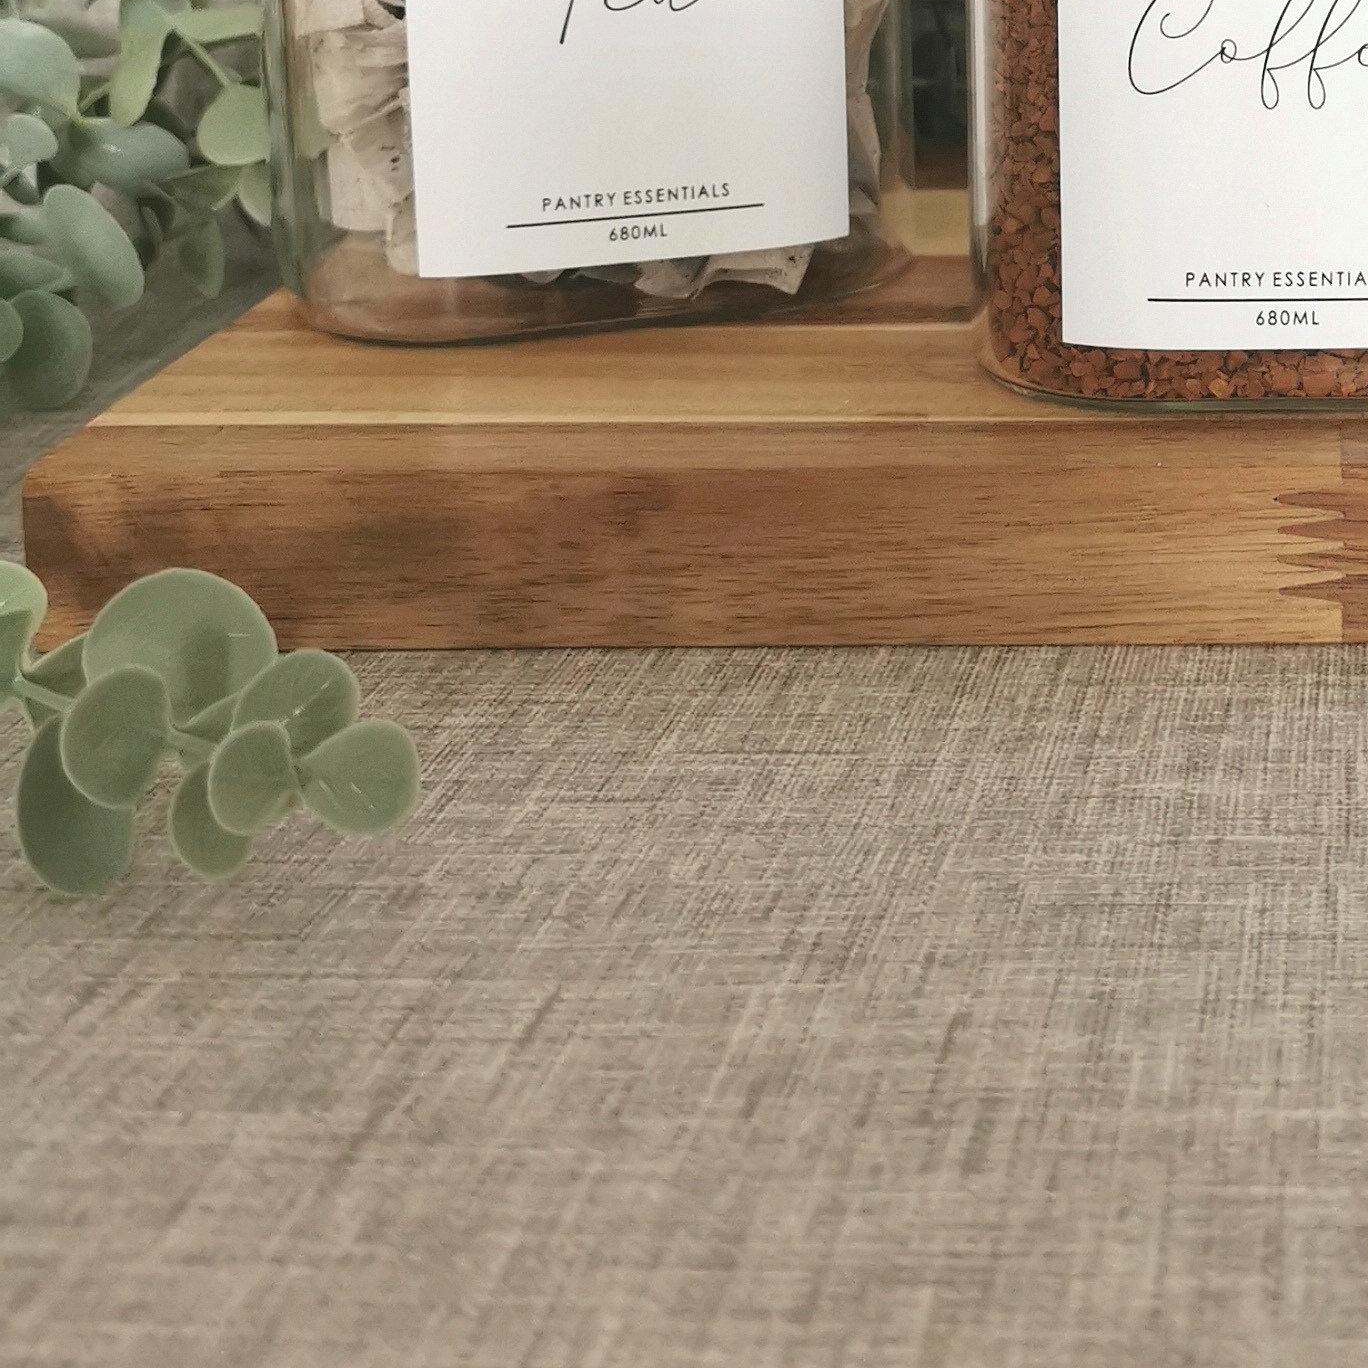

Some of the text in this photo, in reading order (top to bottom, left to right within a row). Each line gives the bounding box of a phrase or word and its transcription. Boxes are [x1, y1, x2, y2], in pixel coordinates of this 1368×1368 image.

[541, 182, 731, 213] PANTRY ESSENTIALS
[608, 223, 669, 243] 680ML
[1185, 271, 1266, 289] PANTRY
[1255, 309, 1320, 327] 680ML
